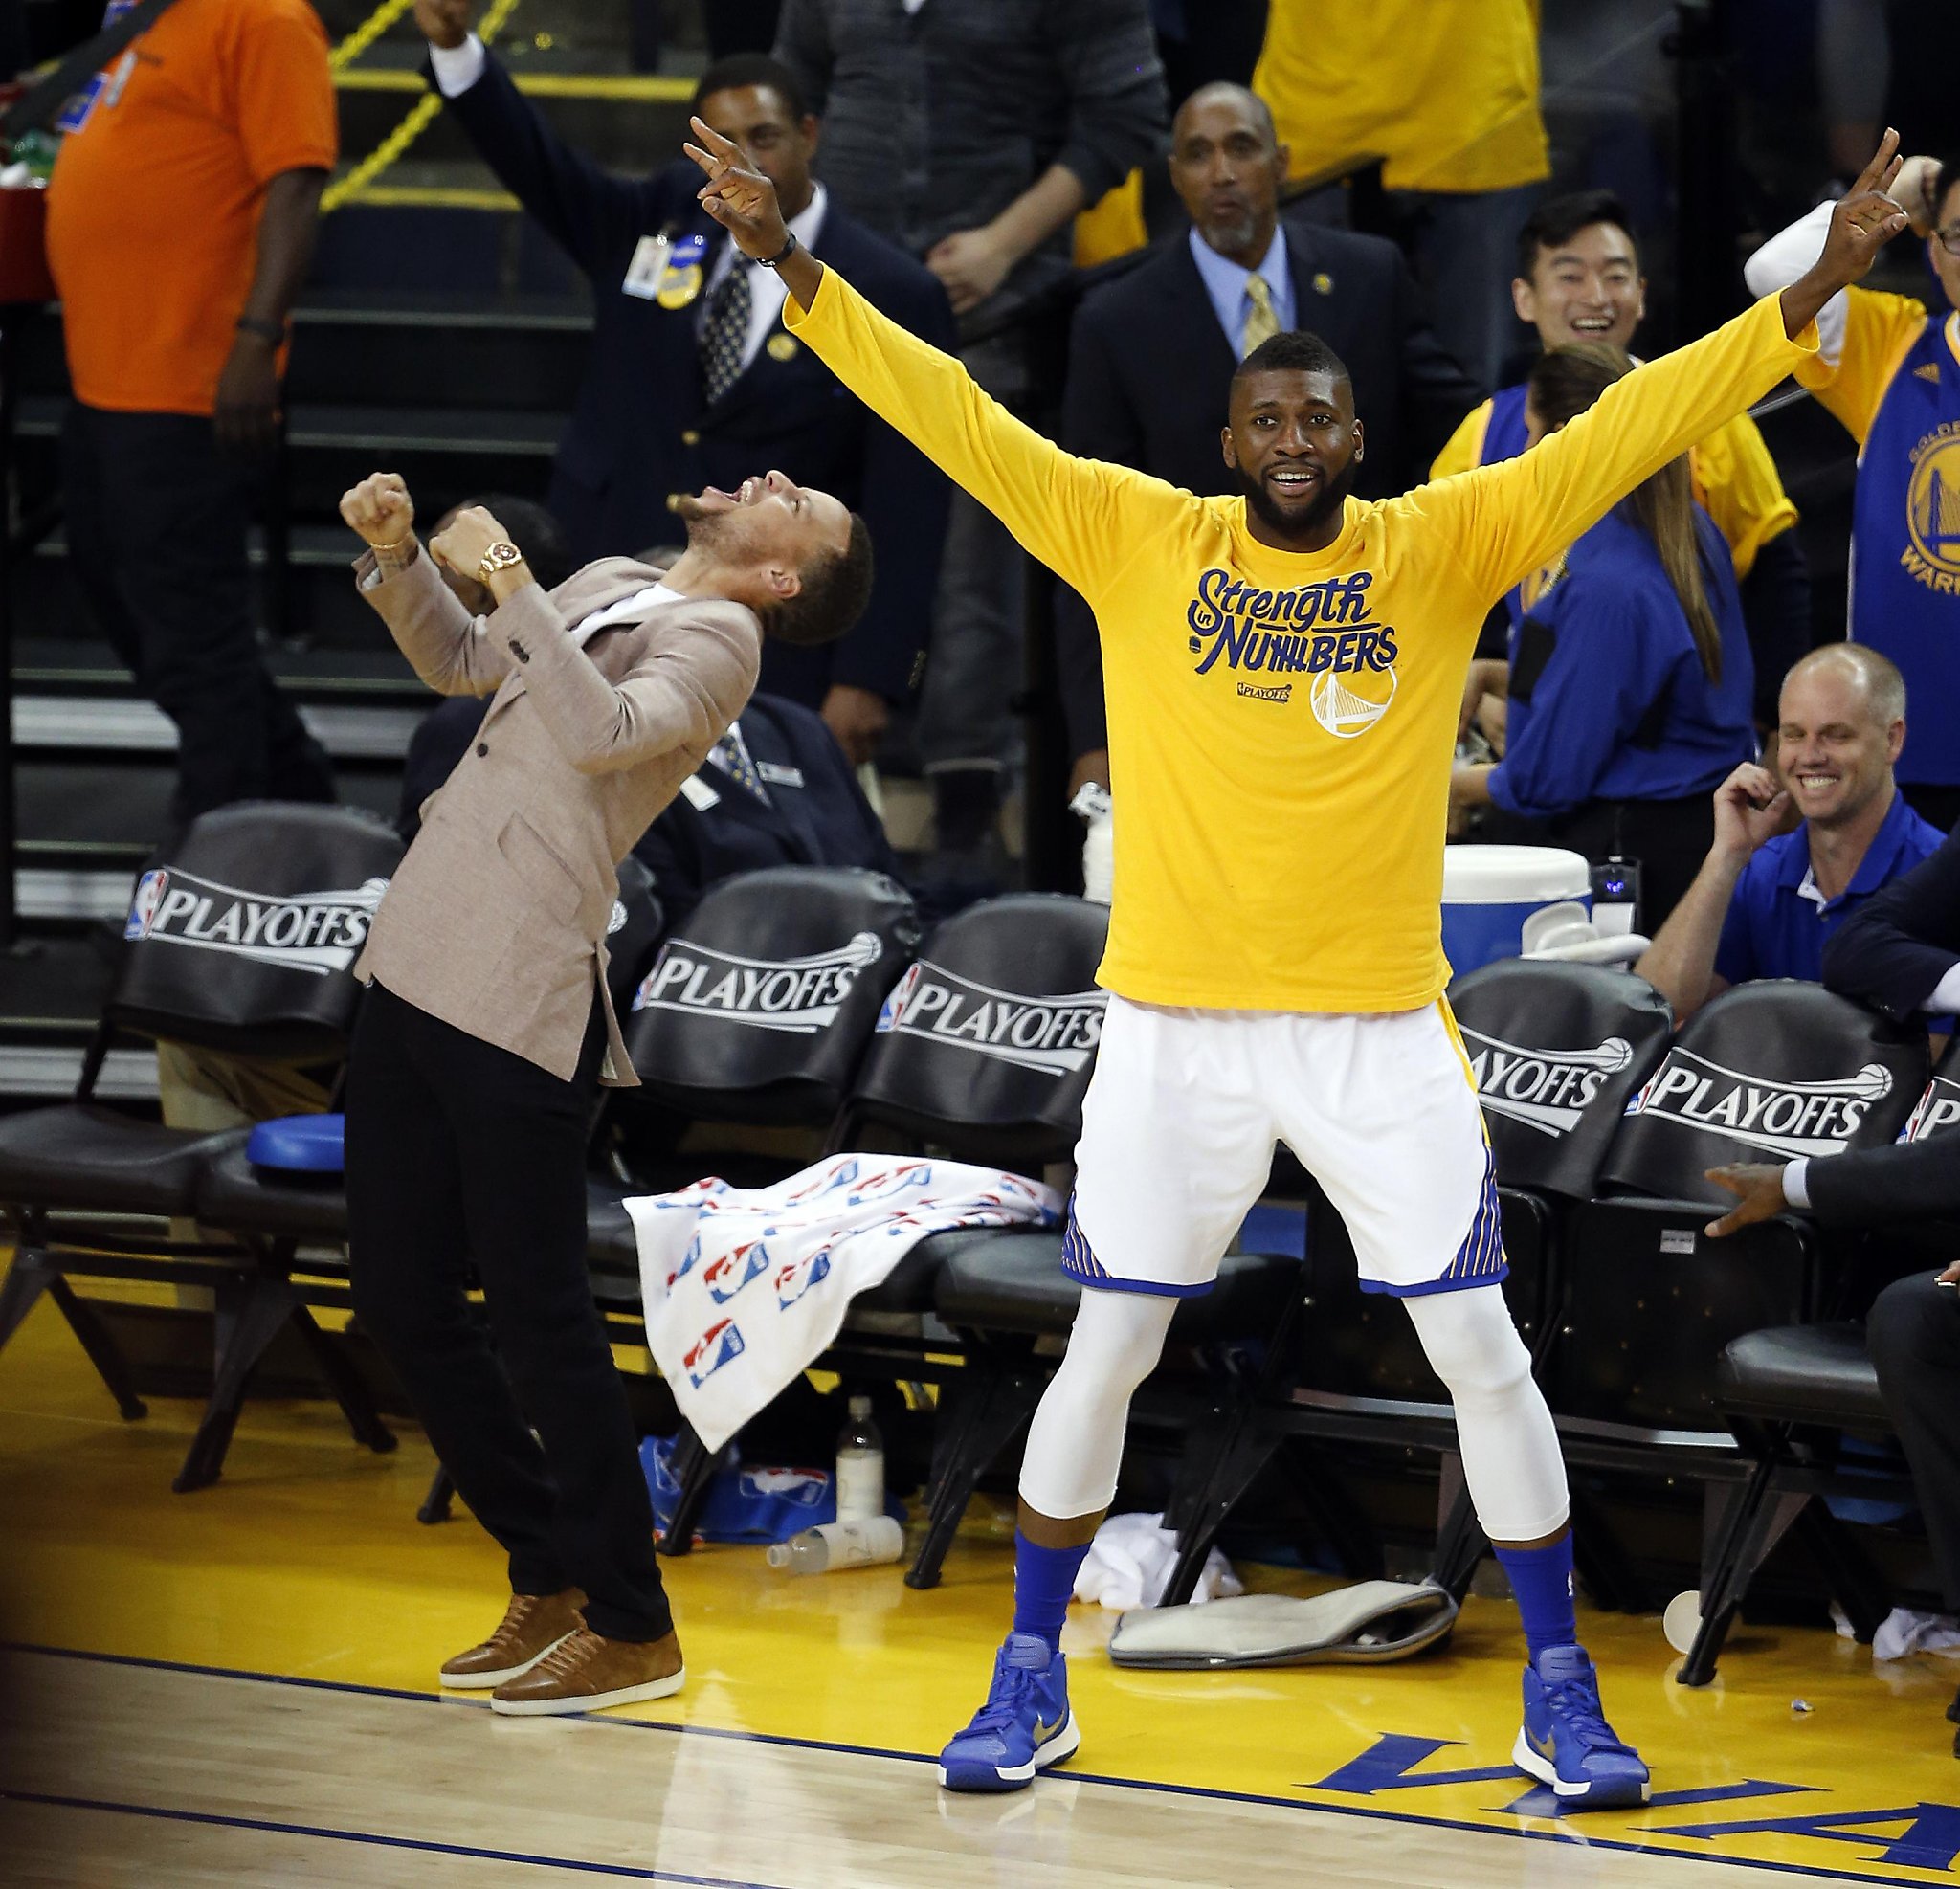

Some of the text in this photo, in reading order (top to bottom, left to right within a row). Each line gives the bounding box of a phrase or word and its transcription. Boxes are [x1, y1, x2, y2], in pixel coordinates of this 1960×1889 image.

[1187, 568, 1372, 636] Strength
[1243, 686, 1290, 699] PLAYOFFS
[151, 889, 373, 947] PLAYOFFS
[650, 957, 860, 1011] PLAYOFFS
[902, 983, 1105, 1049] PLAYOFFS
[1648, 1066, 1872, 1137] PLAYOFFS
